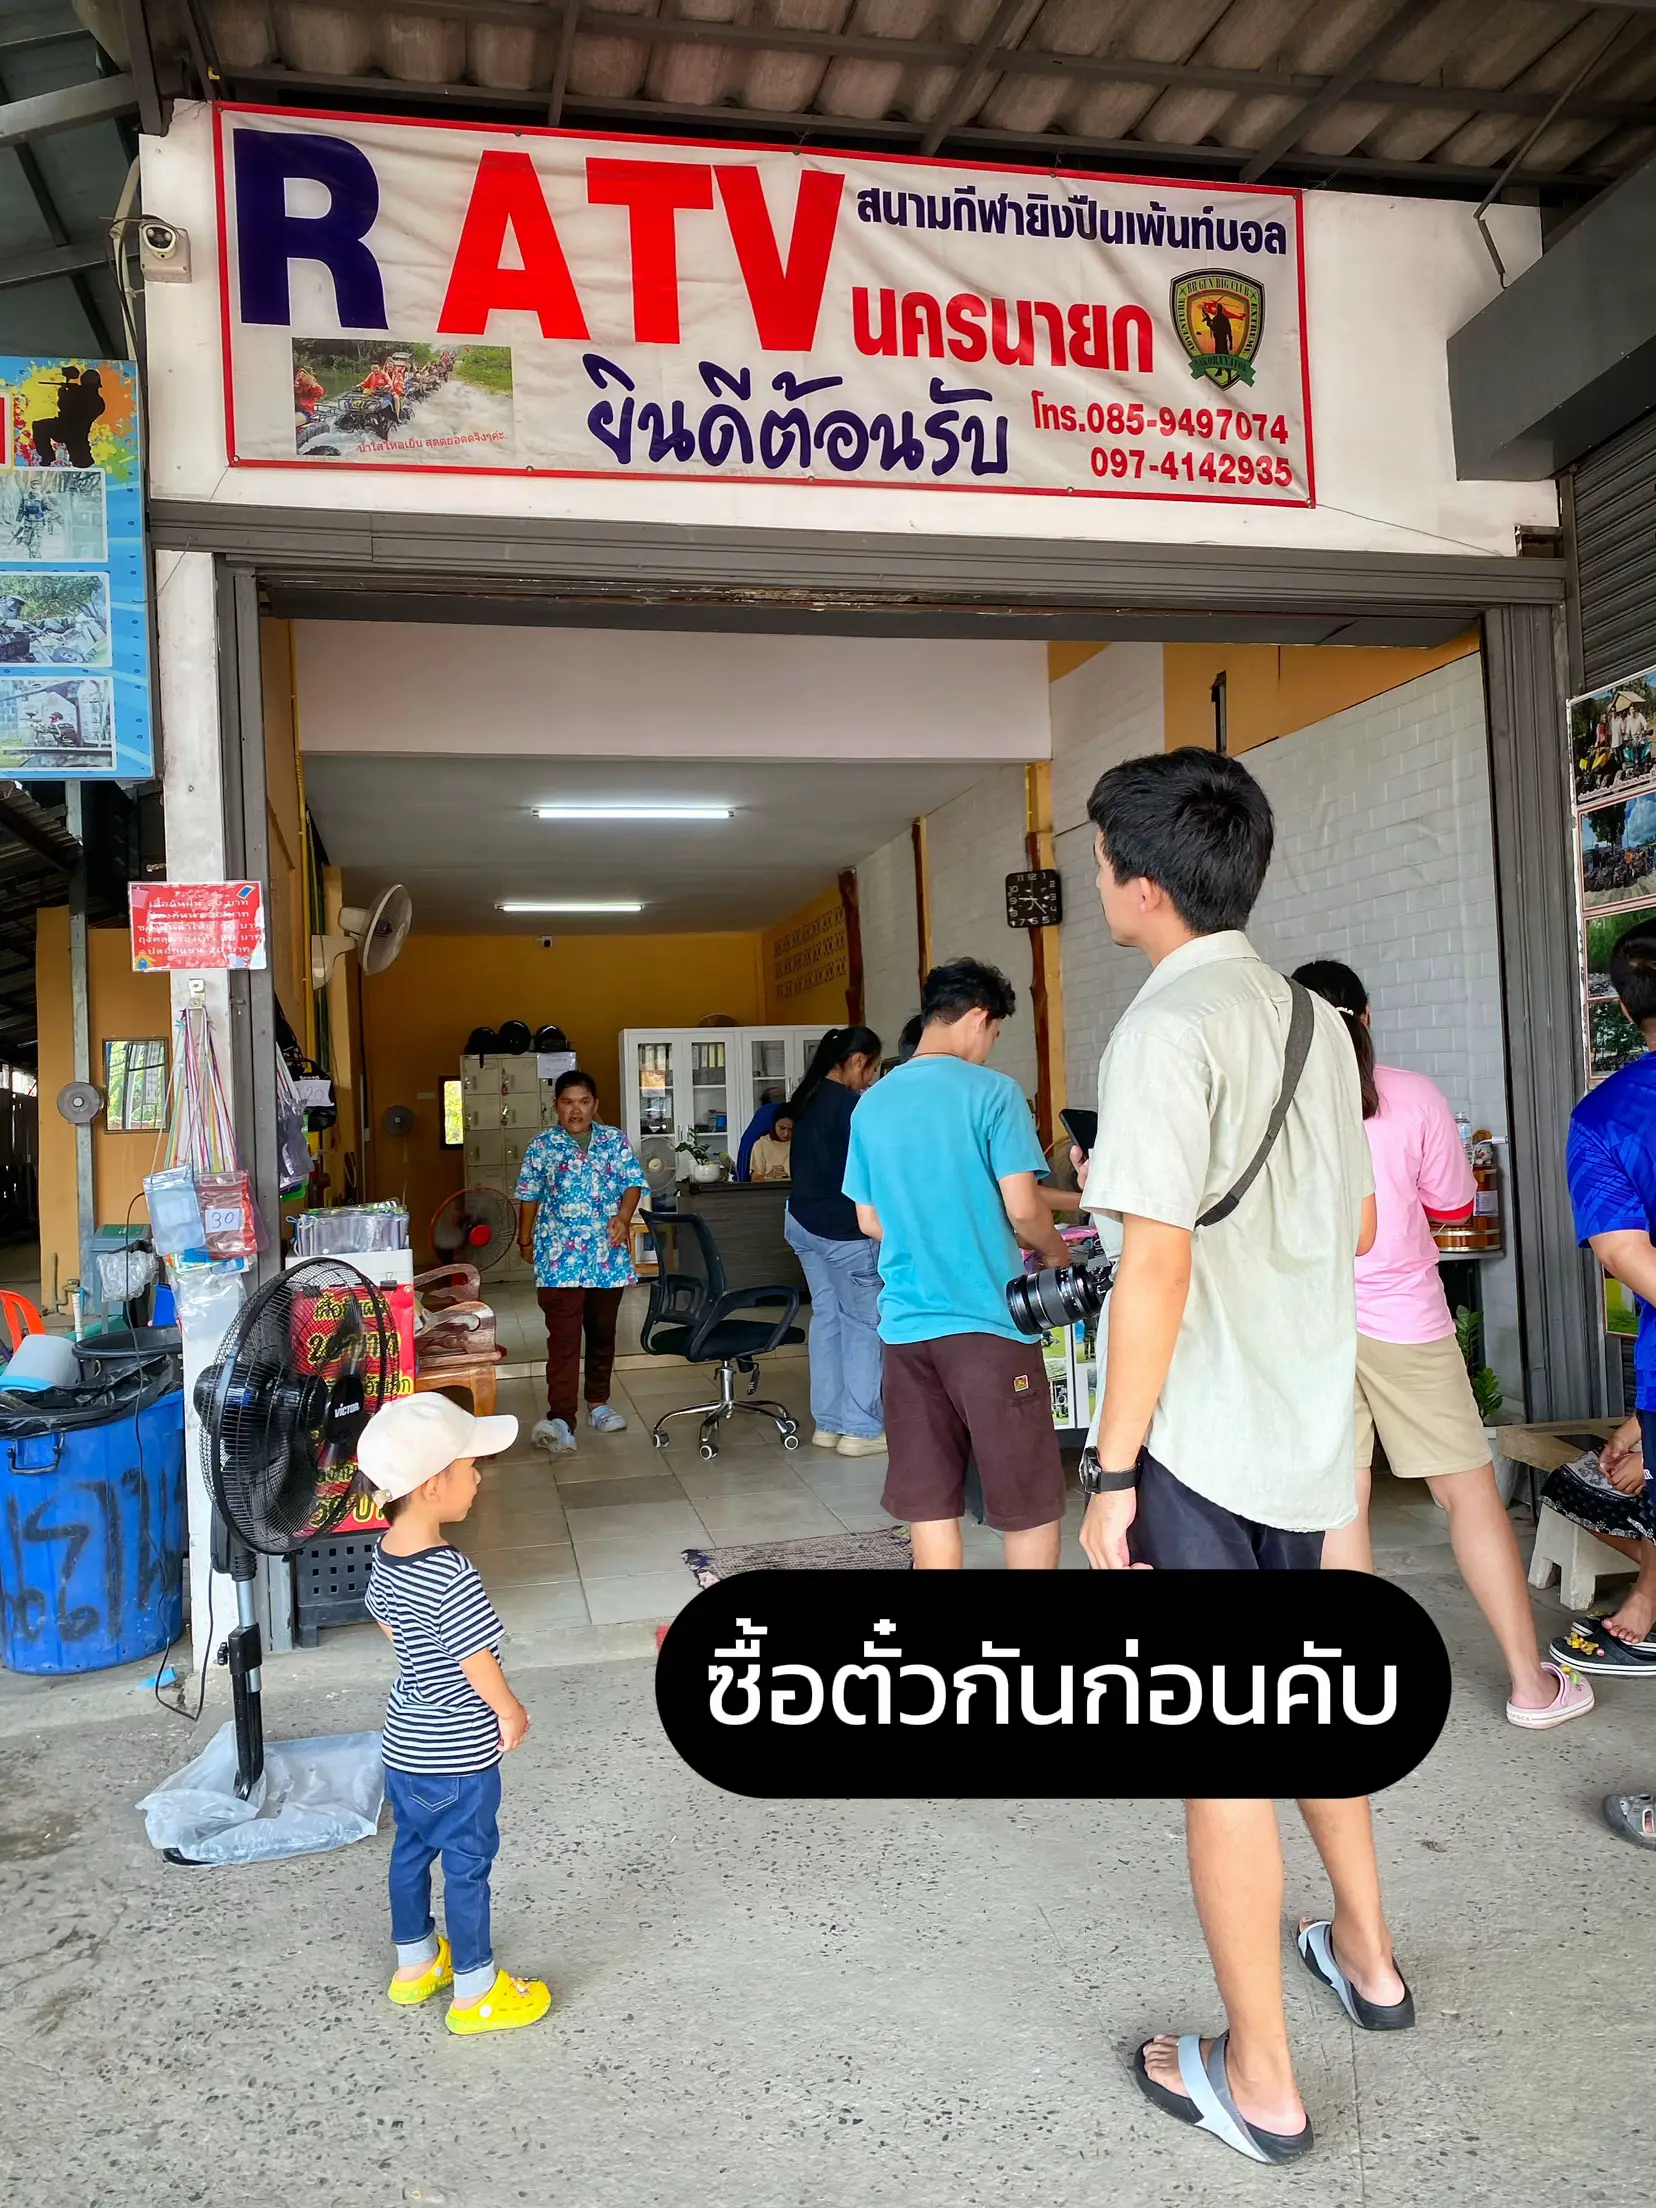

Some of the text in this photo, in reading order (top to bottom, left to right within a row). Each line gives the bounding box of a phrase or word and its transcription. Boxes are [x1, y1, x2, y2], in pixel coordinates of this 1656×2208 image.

[232, 128, 846, 353] R ATV
[857, 186, 1287, 255] สนามกีฬายิงปืนเพ้นท์บอล
[852, 286, 1154, 373] นครนายก
[582, 353, 1008, 477] ยินดีต้อนรับ
[1091, 447, 1293, 487] 097-4142935
[211, 1212, 235, 1229] 30
